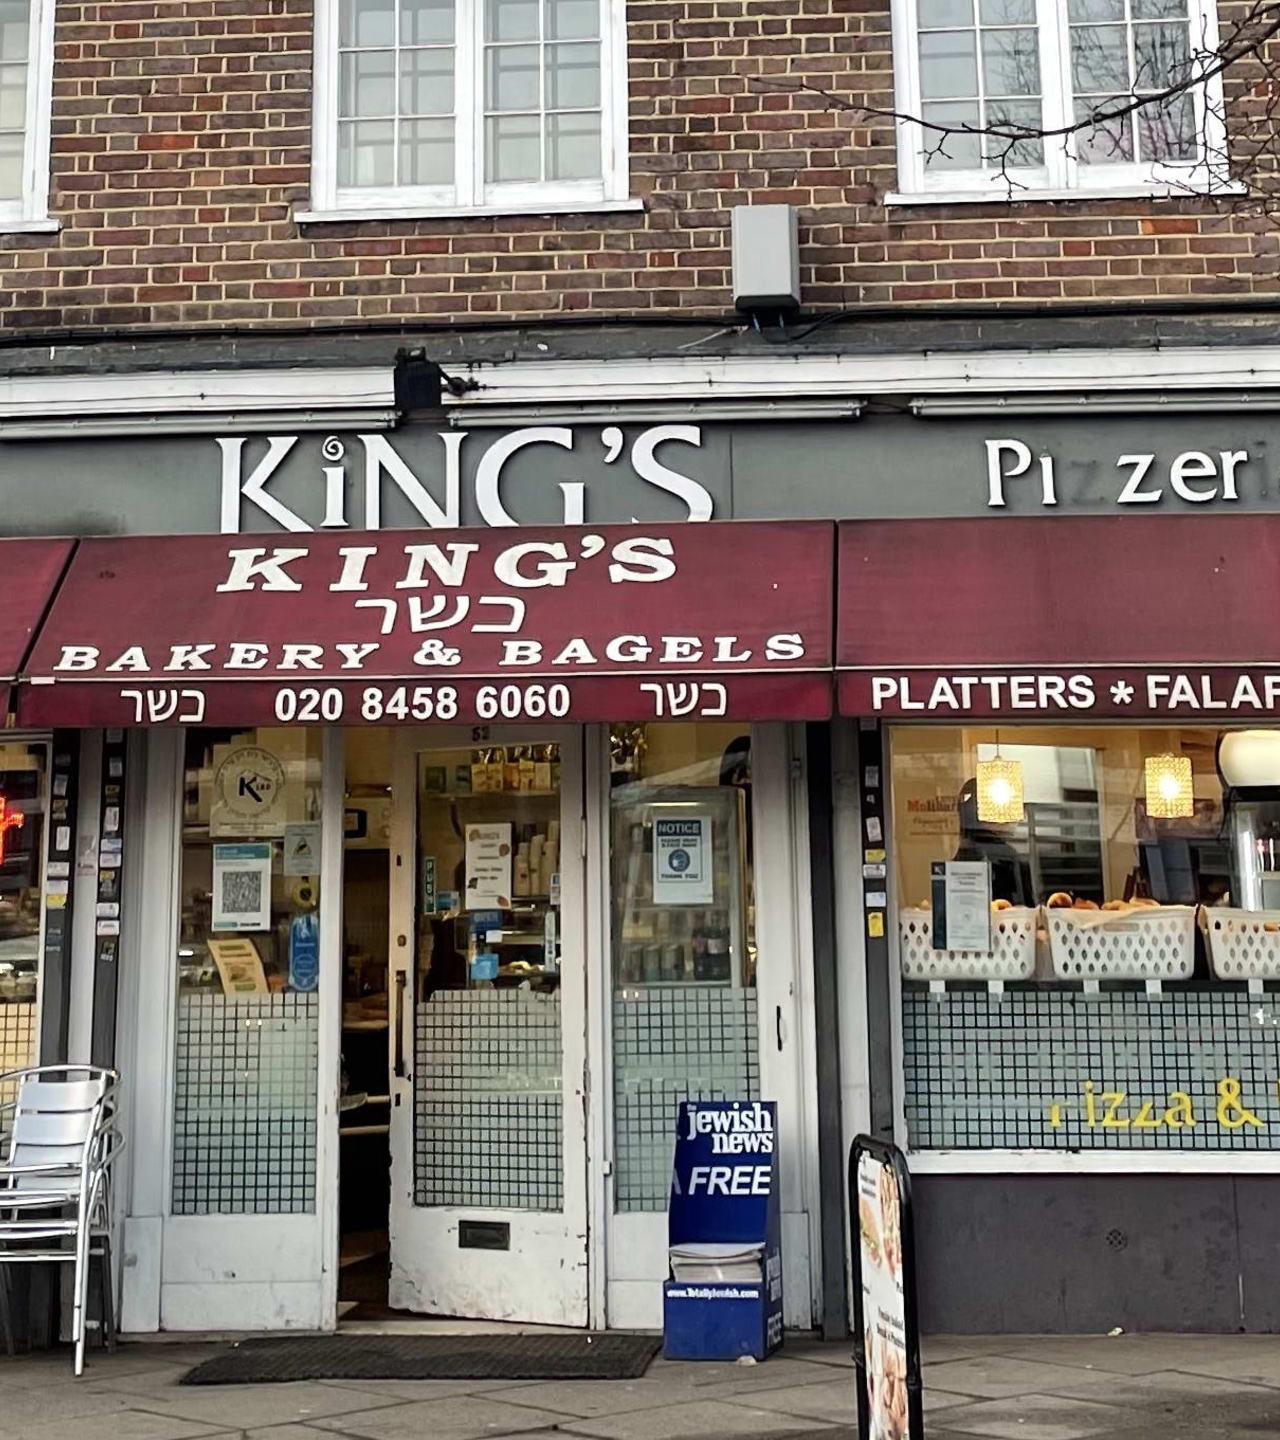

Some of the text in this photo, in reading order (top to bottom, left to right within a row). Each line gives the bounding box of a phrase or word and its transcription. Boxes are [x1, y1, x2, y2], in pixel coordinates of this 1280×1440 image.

[216, 535, 676, 592] KING'S
[354, 594, 526, 635] כשר
[52, 633, 806, 672] BAKERY & BAGELS
[120, 688, 206, 723] כשר
[274, 683, 570, 722] 020 8458 6060
[640, 681, 727, 717] כשר
[871, 674, 1095, 711] PLATTERS
[658, 823, 699, 834] NOTICE
[1216, 1077, 1263, 1129] &
[687, 1103, 773, 1141] jewish
[711, 1132, 773, 1154] news
[688, 1165, 772, 1195] FREE
